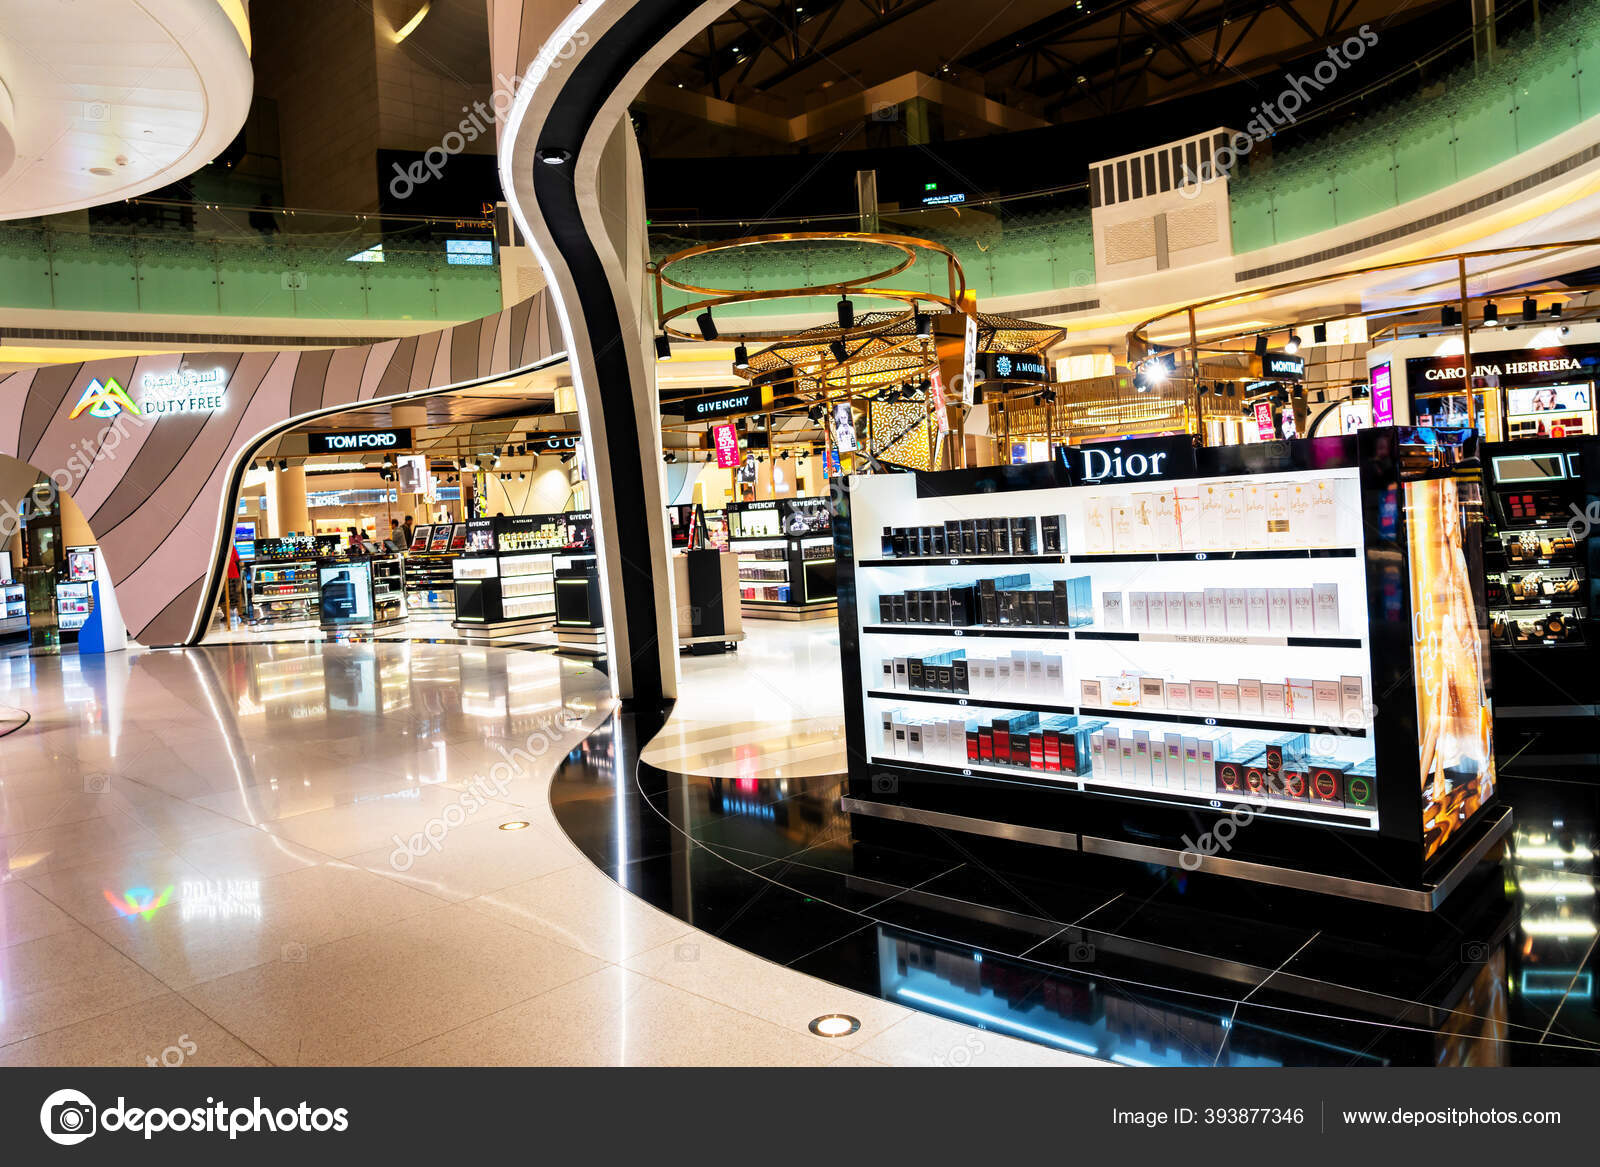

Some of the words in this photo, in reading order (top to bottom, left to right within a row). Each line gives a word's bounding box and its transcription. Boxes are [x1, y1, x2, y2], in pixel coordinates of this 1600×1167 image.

[1505, 358, 1582, 375] HERRERA
[146, 399, 187, 414] DUTY
[189, 396, 222, 410] FREE
[697, 396, 749, 413] GIVENCHY
[325, 436, 357, 449] TOM
[358, 433, 397, 447] FORD
[1080, 447, 1167, 481] Dior
[748, 502, 776, 510] GIVENCHY
[570, 513, 593, 521] GIVENCH
[1206, 636, 1248, 644] FRAGRANCE
